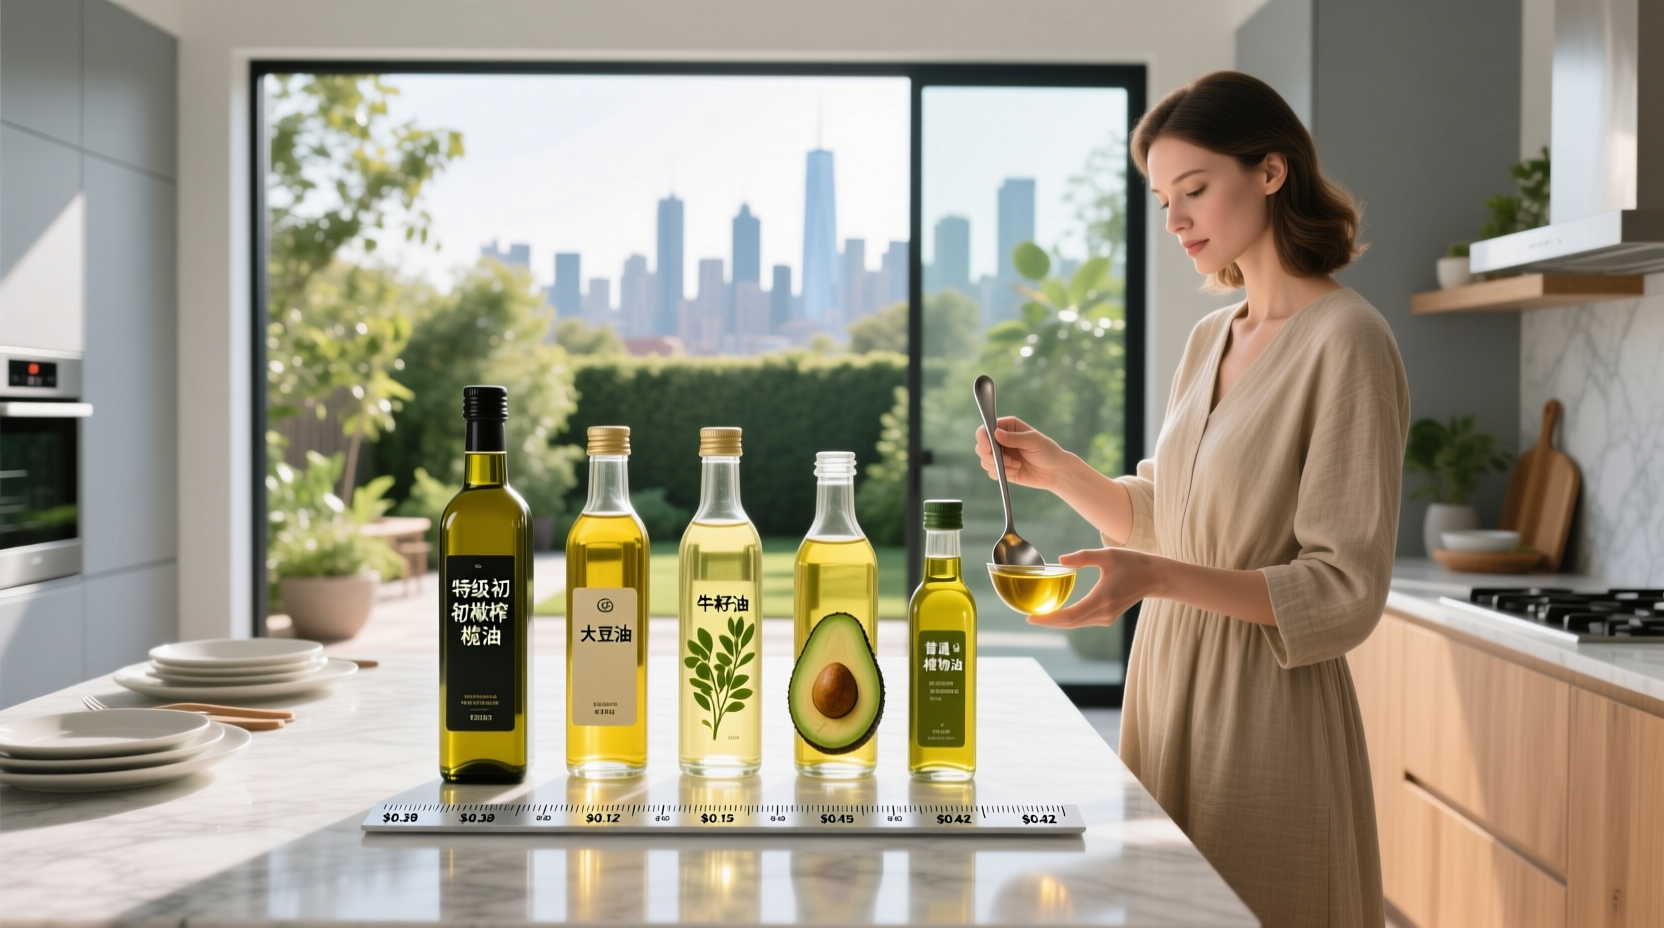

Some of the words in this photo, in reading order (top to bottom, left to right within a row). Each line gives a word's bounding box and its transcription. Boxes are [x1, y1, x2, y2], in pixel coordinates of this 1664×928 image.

[697, 594, 749, 613] 牛籽油
[580, 624, 632, 643] 大豆油
[585, 813, 621, 825] $0.12
[700, 813, 735, 825] $0.15
